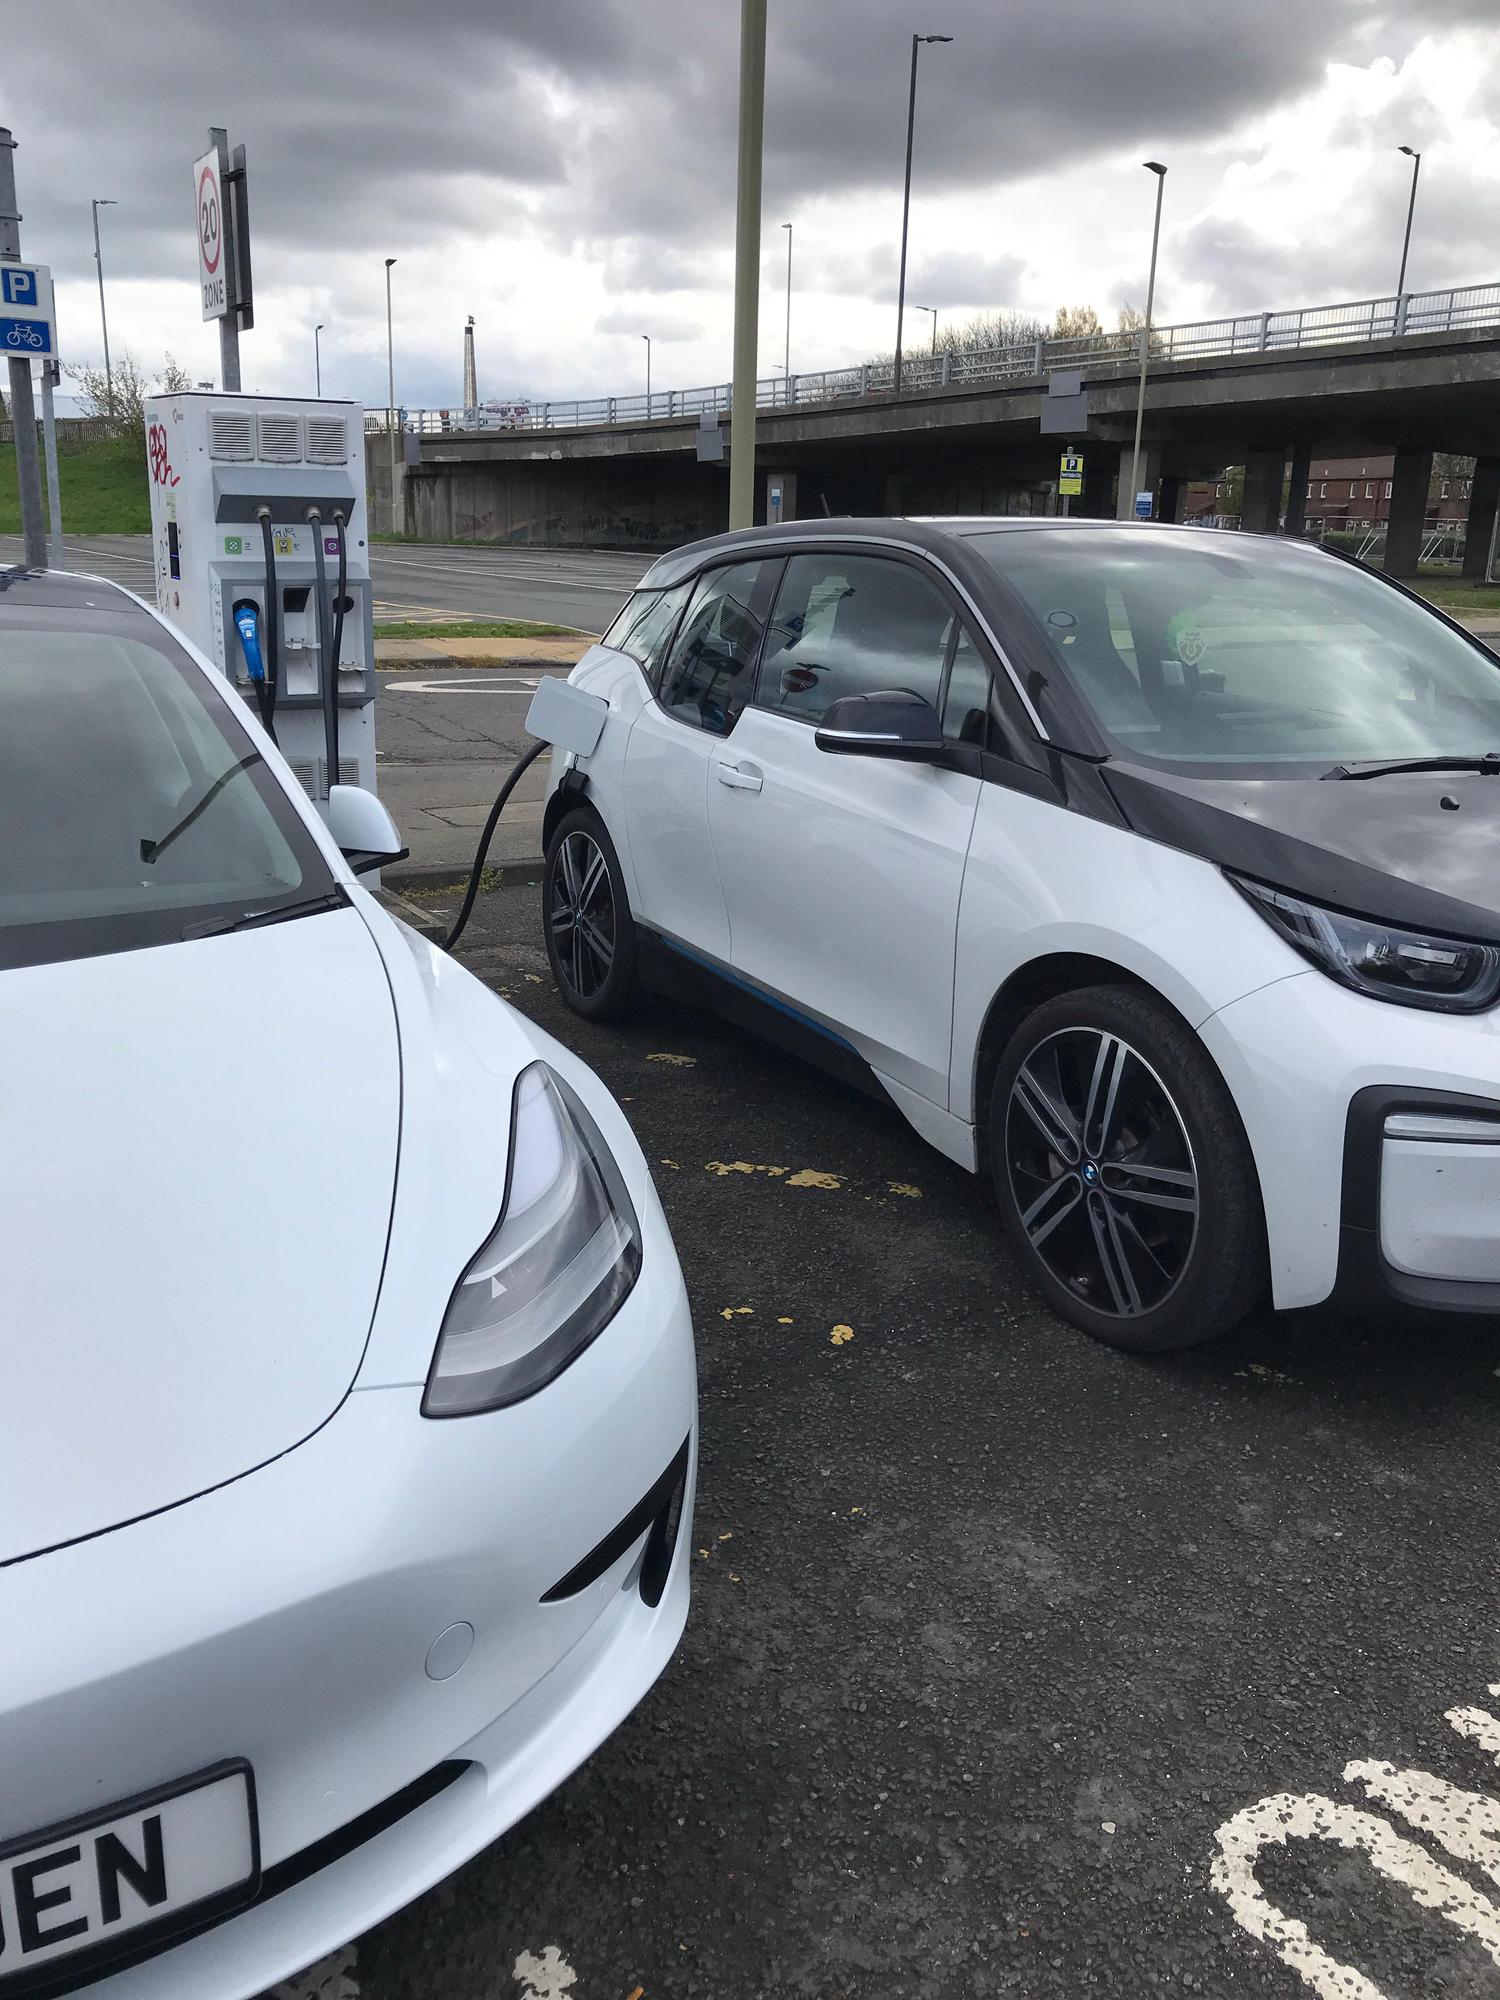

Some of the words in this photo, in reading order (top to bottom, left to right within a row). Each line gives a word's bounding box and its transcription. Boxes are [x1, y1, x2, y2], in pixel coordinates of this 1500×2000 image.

[201, 198, 217, 244] 20
[8, 271, 31, 302] P
[204, 279, 224, 309] ZONE
[0, 1814, 168, 1957] EN
